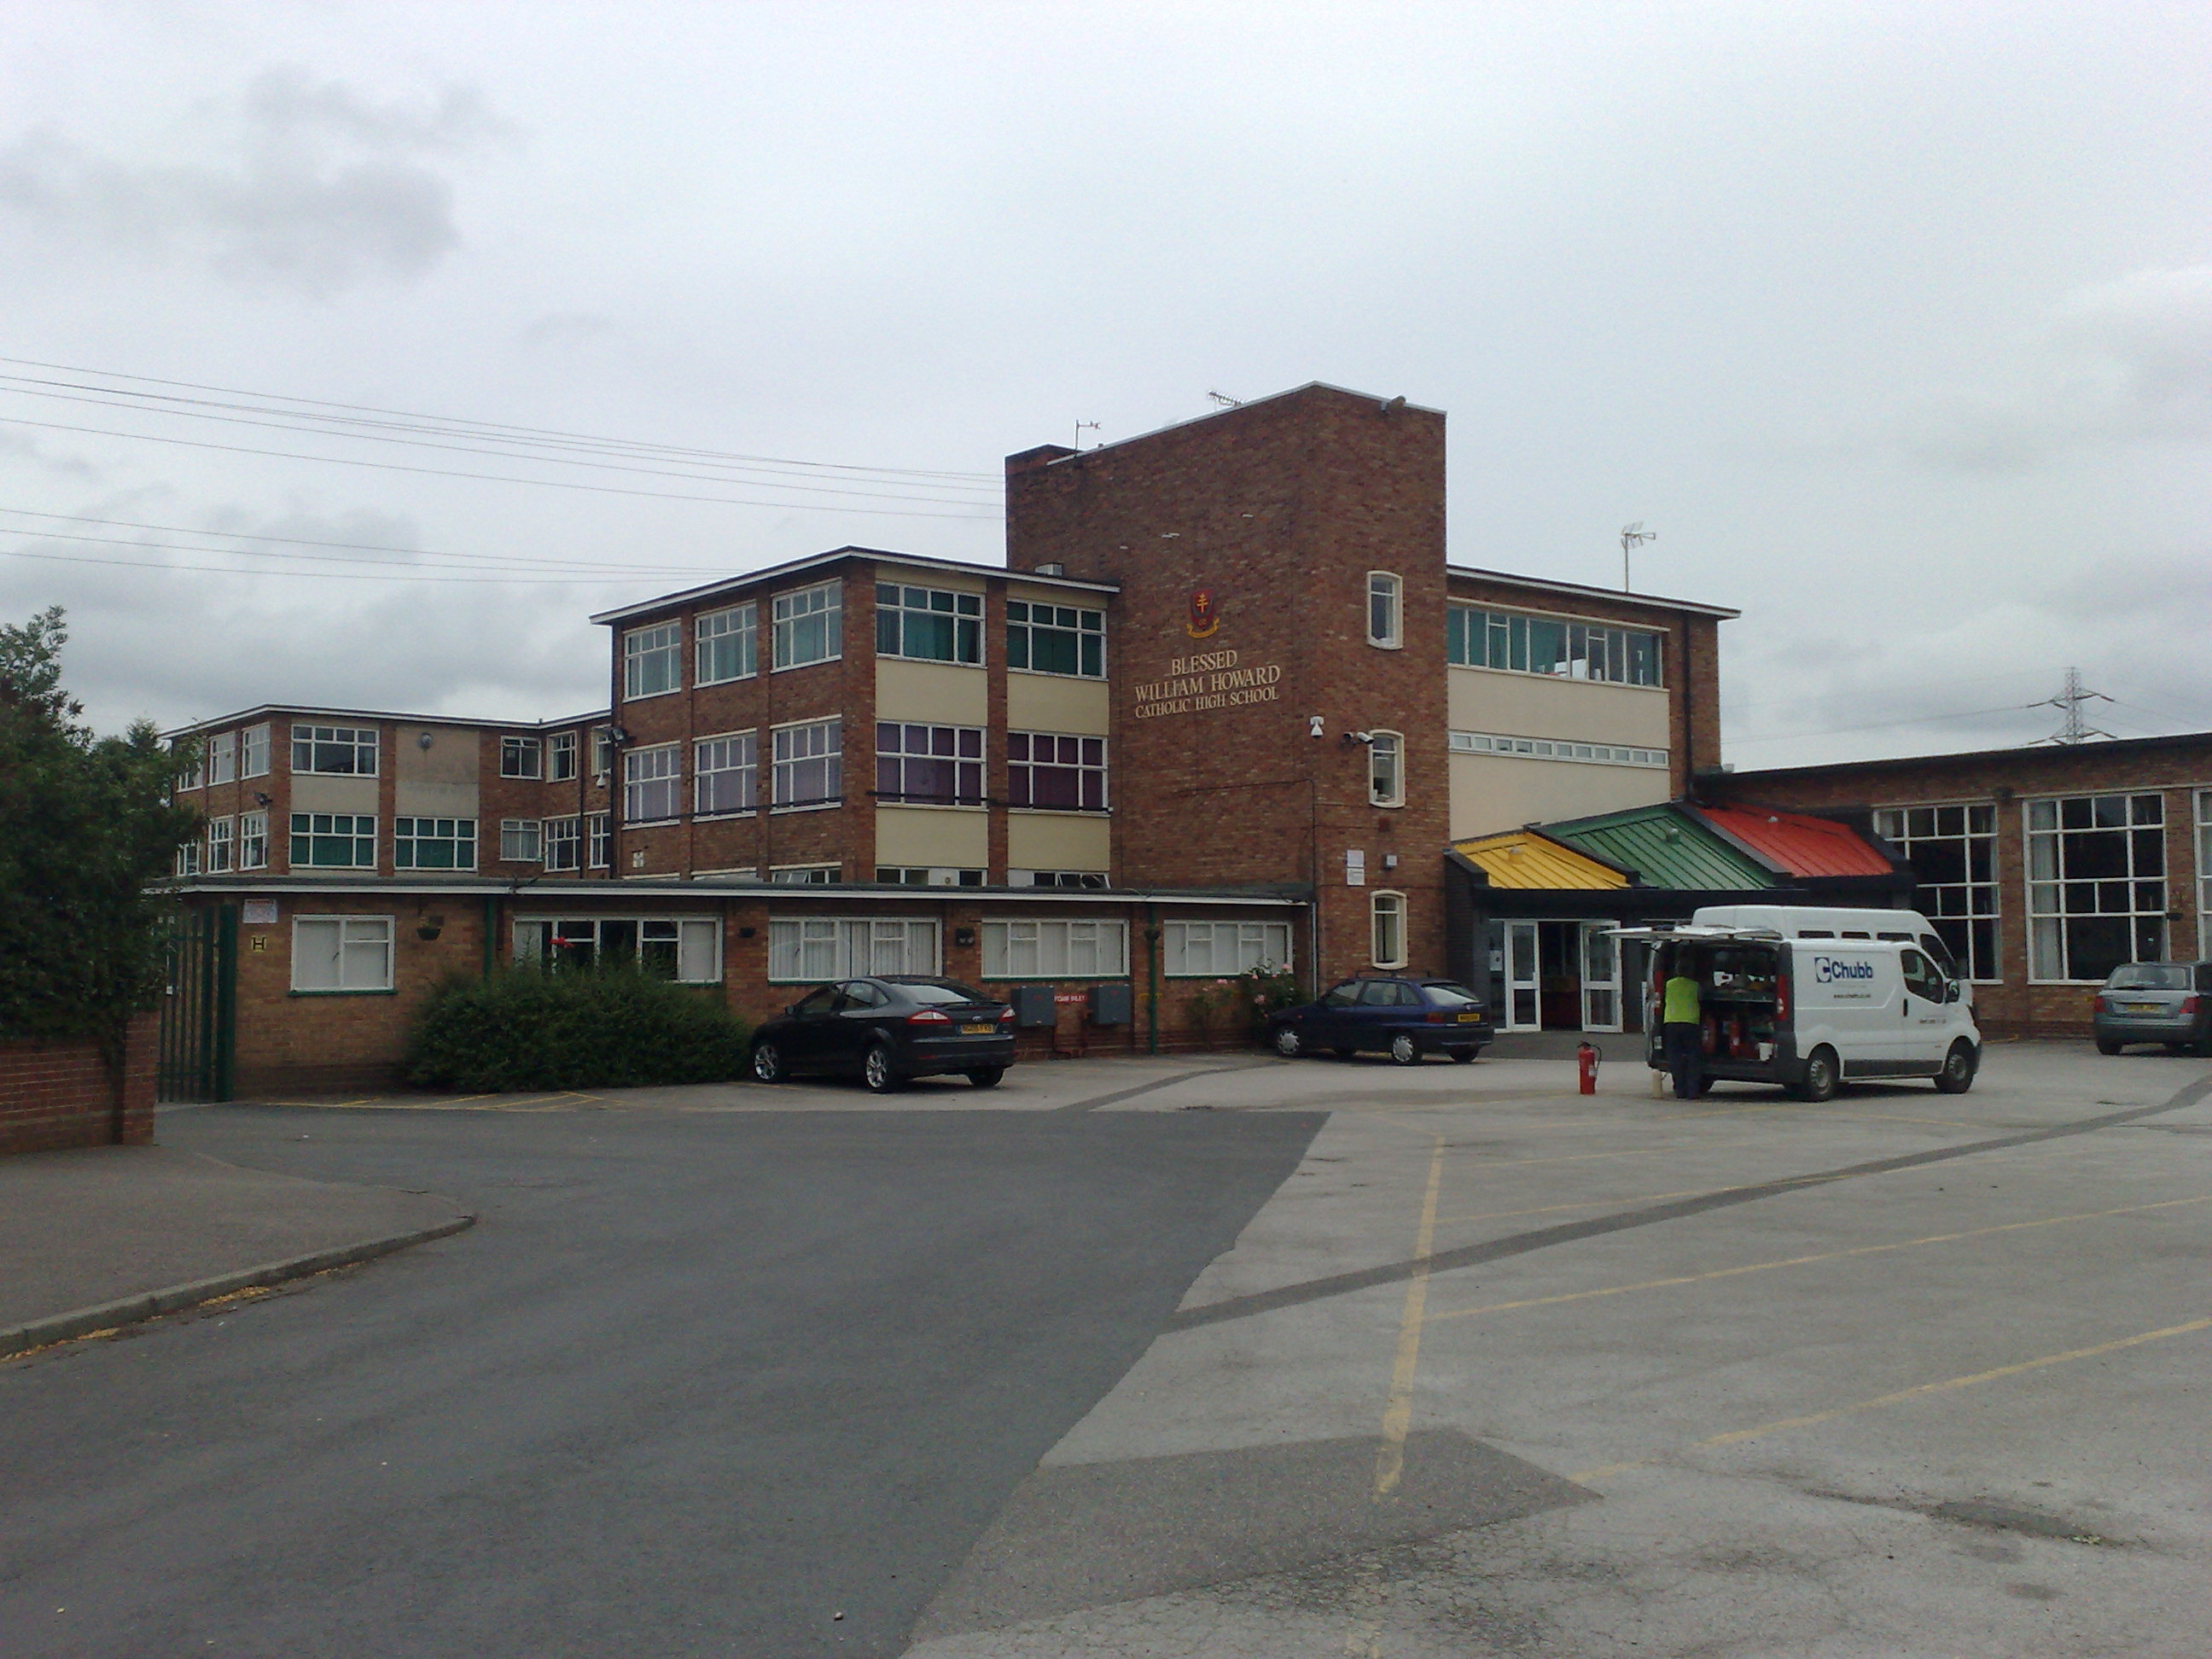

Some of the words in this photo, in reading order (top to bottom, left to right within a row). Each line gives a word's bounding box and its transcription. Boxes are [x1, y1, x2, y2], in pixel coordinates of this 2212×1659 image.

[1171, 649, 1237, 676] BLESSED
[1134, 676, 1204, 702] WILLIAM
[1210, 664, 1281, 692] HOWARD
[1135, 698, 1191, 719] CATHOLIC
[1195, 693, 1226, 711] HIGH
[1230, 686, 1279, 707] SCHOOL
[253, 936, 265, 951] H
[1831, 961, 1873, 979] Chubb
